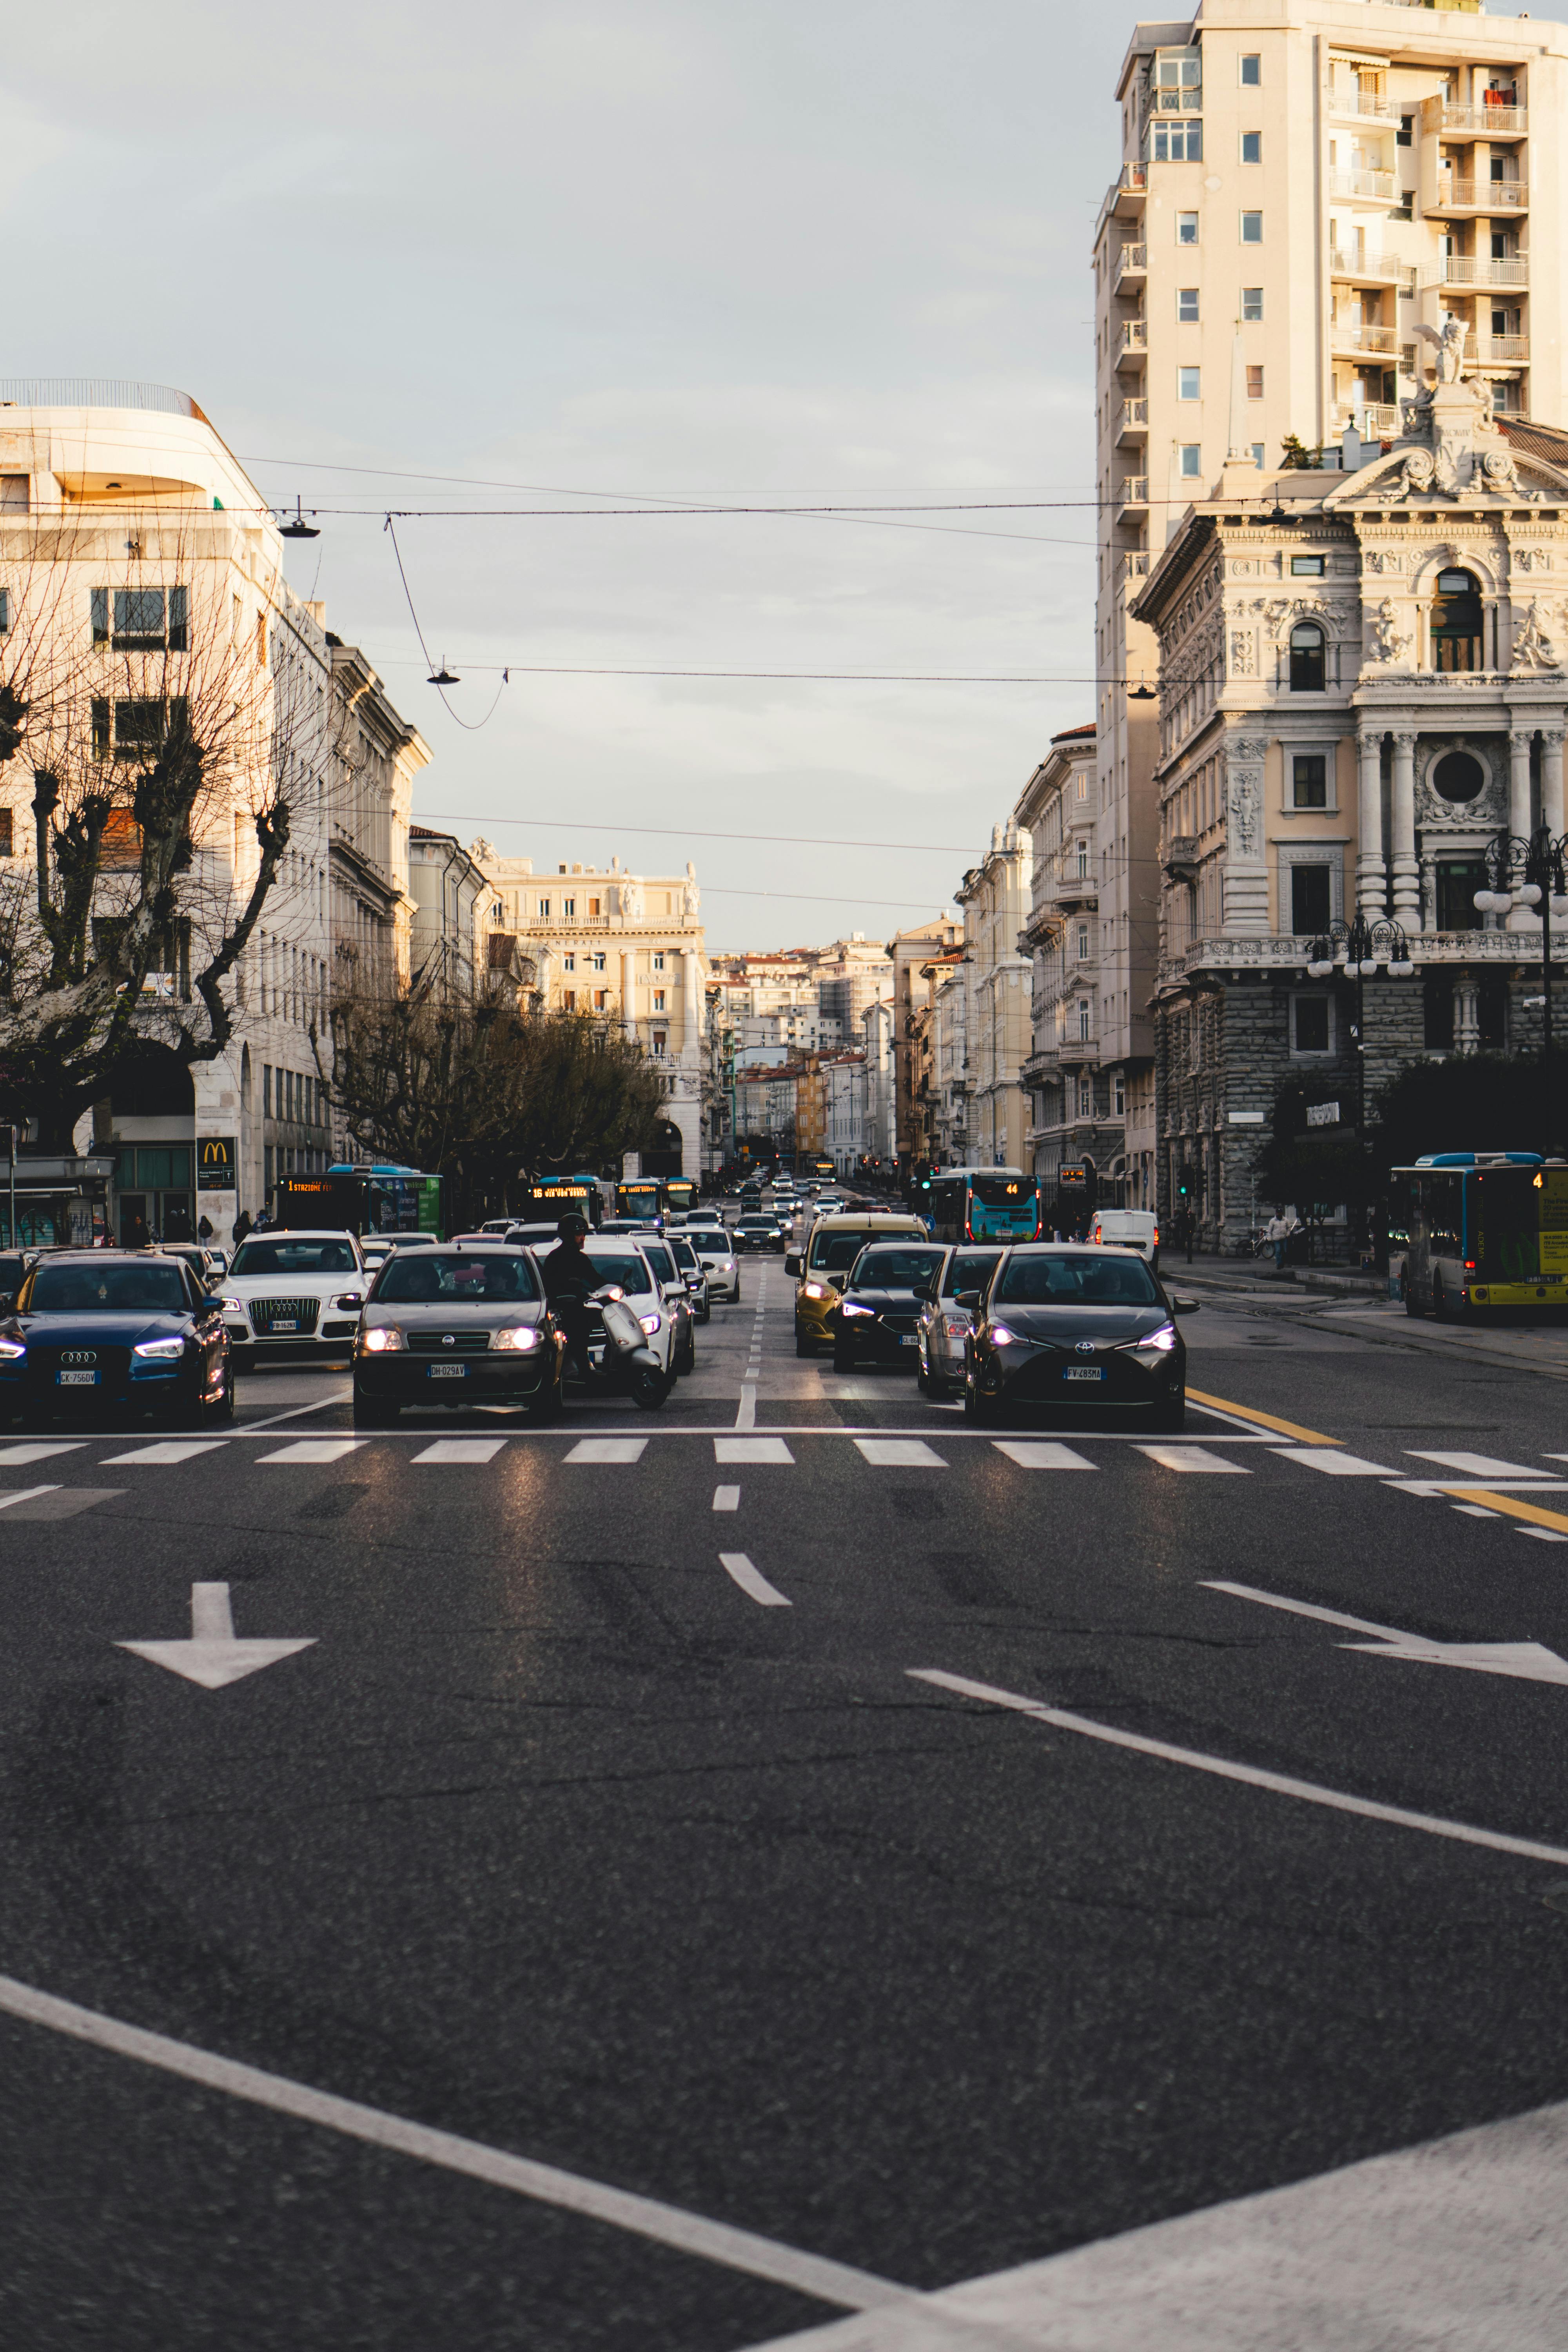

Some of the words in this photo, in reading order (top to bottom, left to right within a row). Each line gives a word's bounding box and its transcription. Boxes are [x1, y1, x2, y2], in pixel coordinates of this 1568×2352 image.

[1533, 1172, 1543, 1188] 4
[289, 1180, 293, 1191] 1
[1007, 1184, 1018, 1194] 44
[534, 1188, 543, 1198] 16
